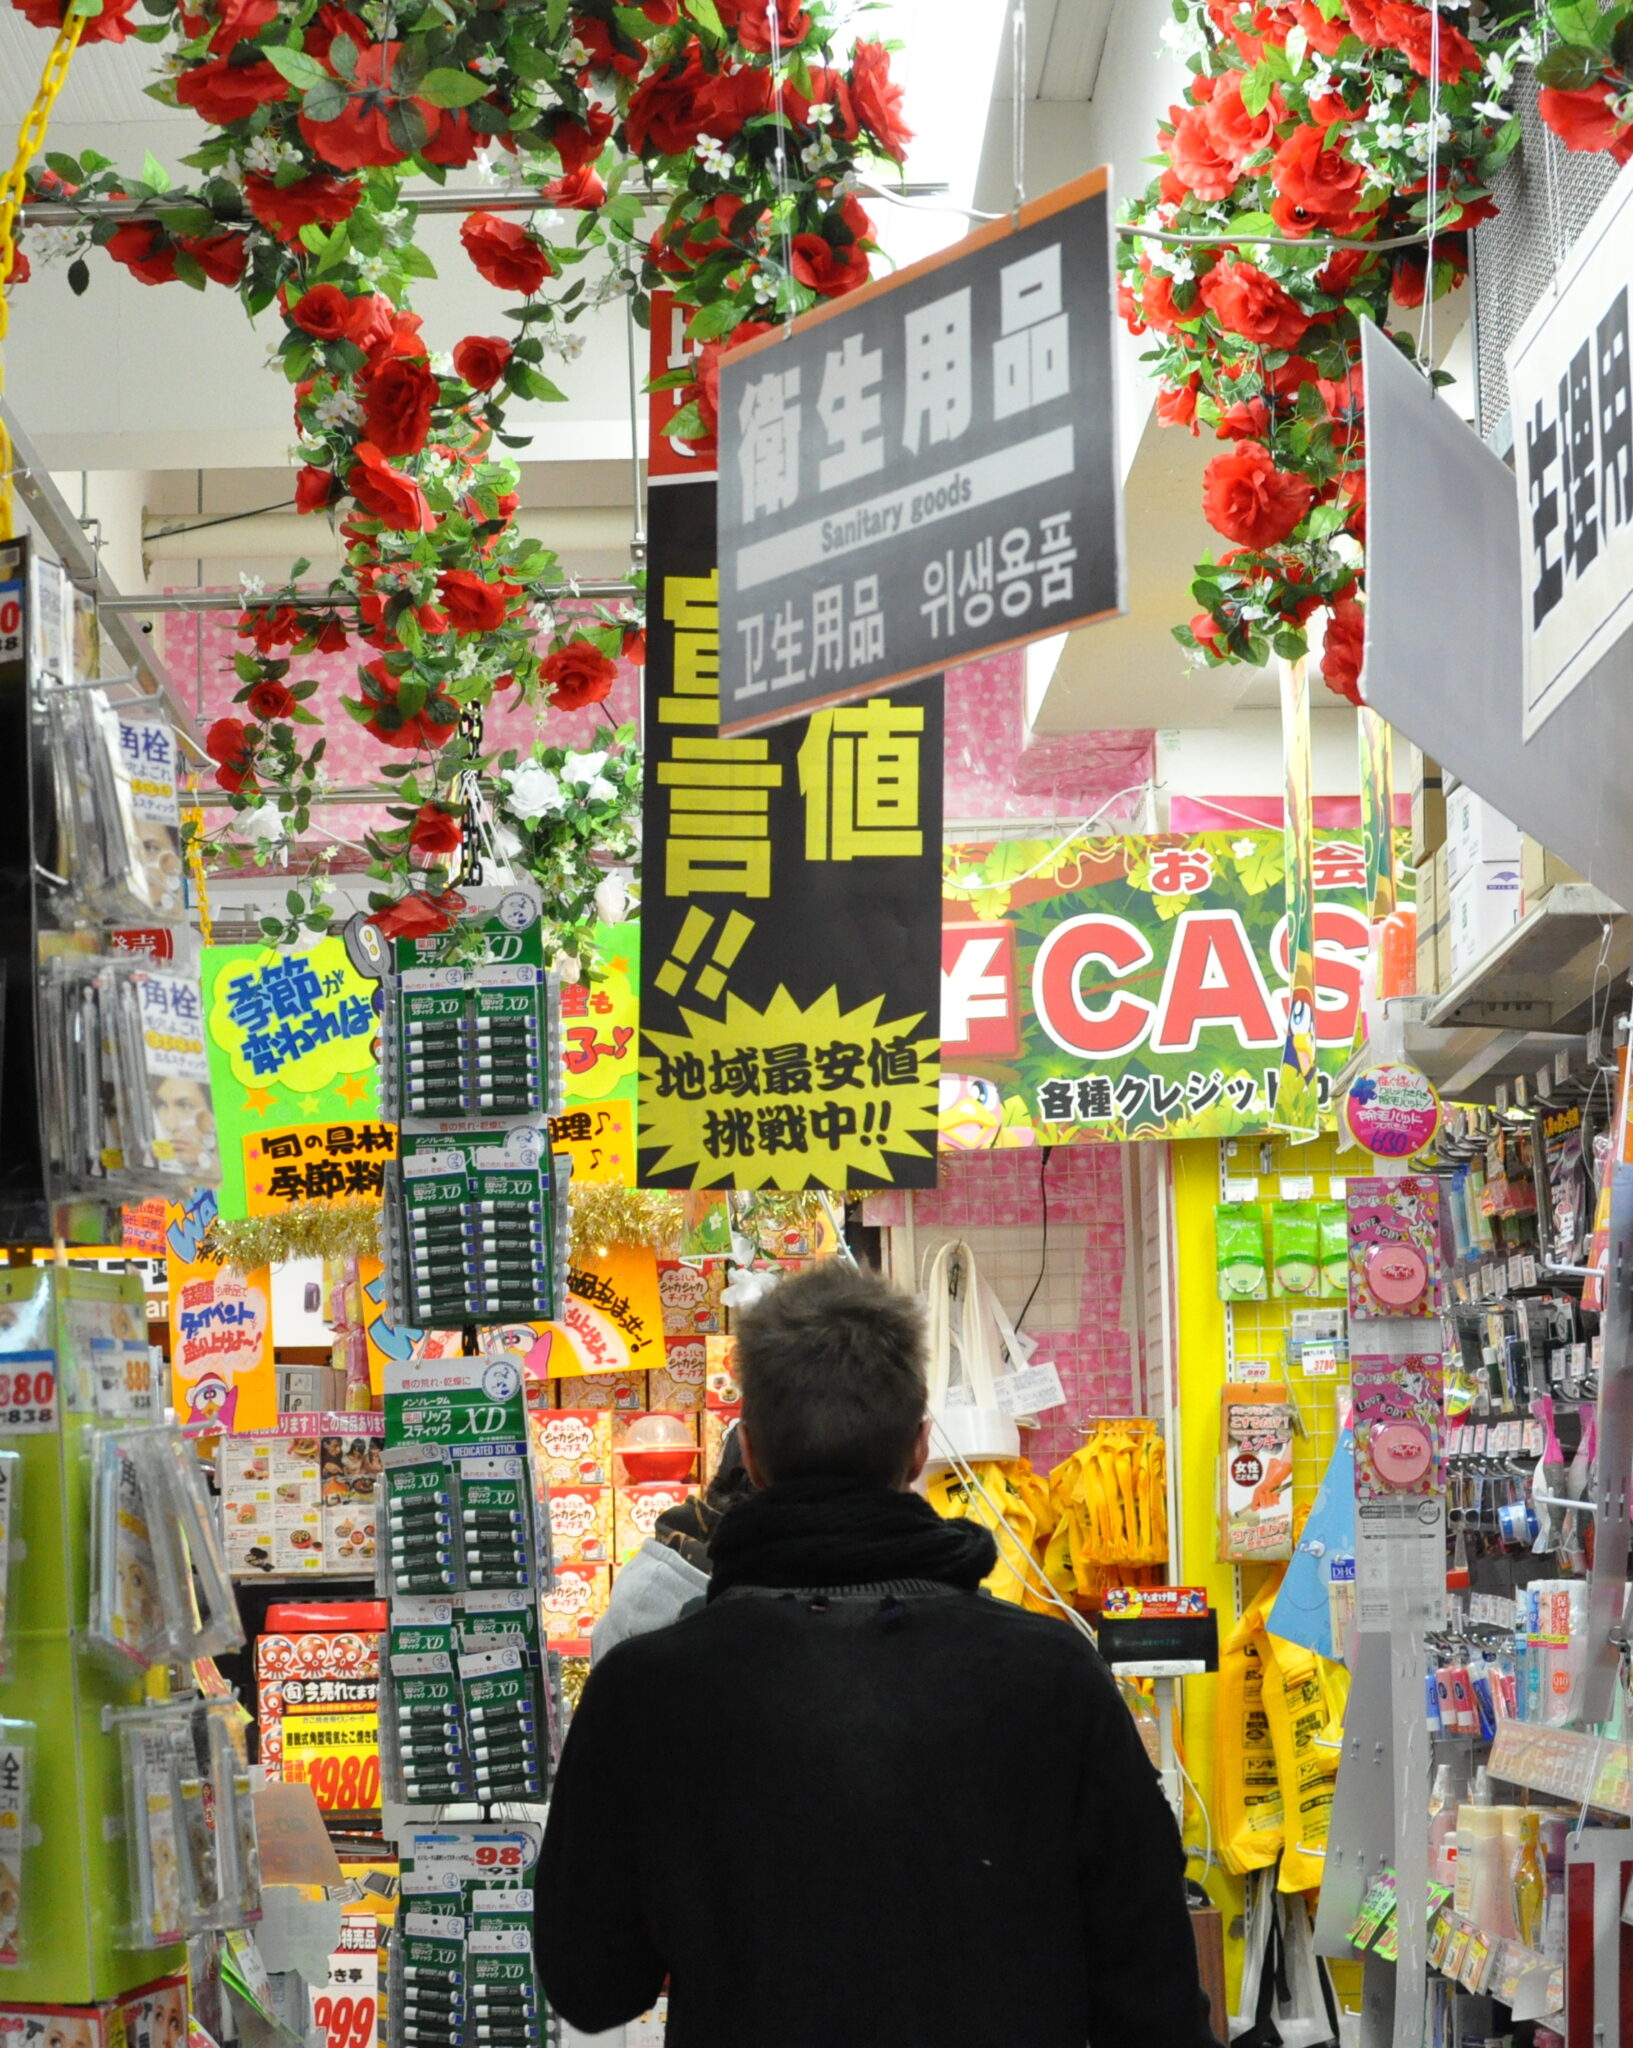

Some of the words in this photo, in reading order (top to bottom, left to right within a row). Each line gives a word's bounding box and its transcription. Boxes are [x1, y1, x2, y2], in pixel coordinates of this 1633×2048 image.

[737, 241, 1070, 525] 衛生用品
[821, 503, 905, 554] Sanitary
[911, 474, 972, 524] goods
[921, 511, 1077, 639] 위생용품
[734, 574, 885, 701] 卫生用品
[142, 981, 198, 1019] 角栓
[655, 1035, 920, 1101] 地域最安値
[261, 1124, 394, 1159] 旬の具材
[702, 1100, 892, 1160] 挑戦中!!
[1369, 1130, 1408, 1153] 630
[669, 1358, 705, 1369] シャカシャ
[403, 1424, 451, 1438] スティック
[457, 1407, 507, 1435] XD
[452, 1445, 493, 1457] MEDICATED
[495, 1444, 517, 1455] STICK
[553, 1444, 581, 1452] チップス
[1235, 1462, 1259, 1474] 女性
[308, 1755, 380, 1810] 1980
[475, 1846, 521, 1866] 98
